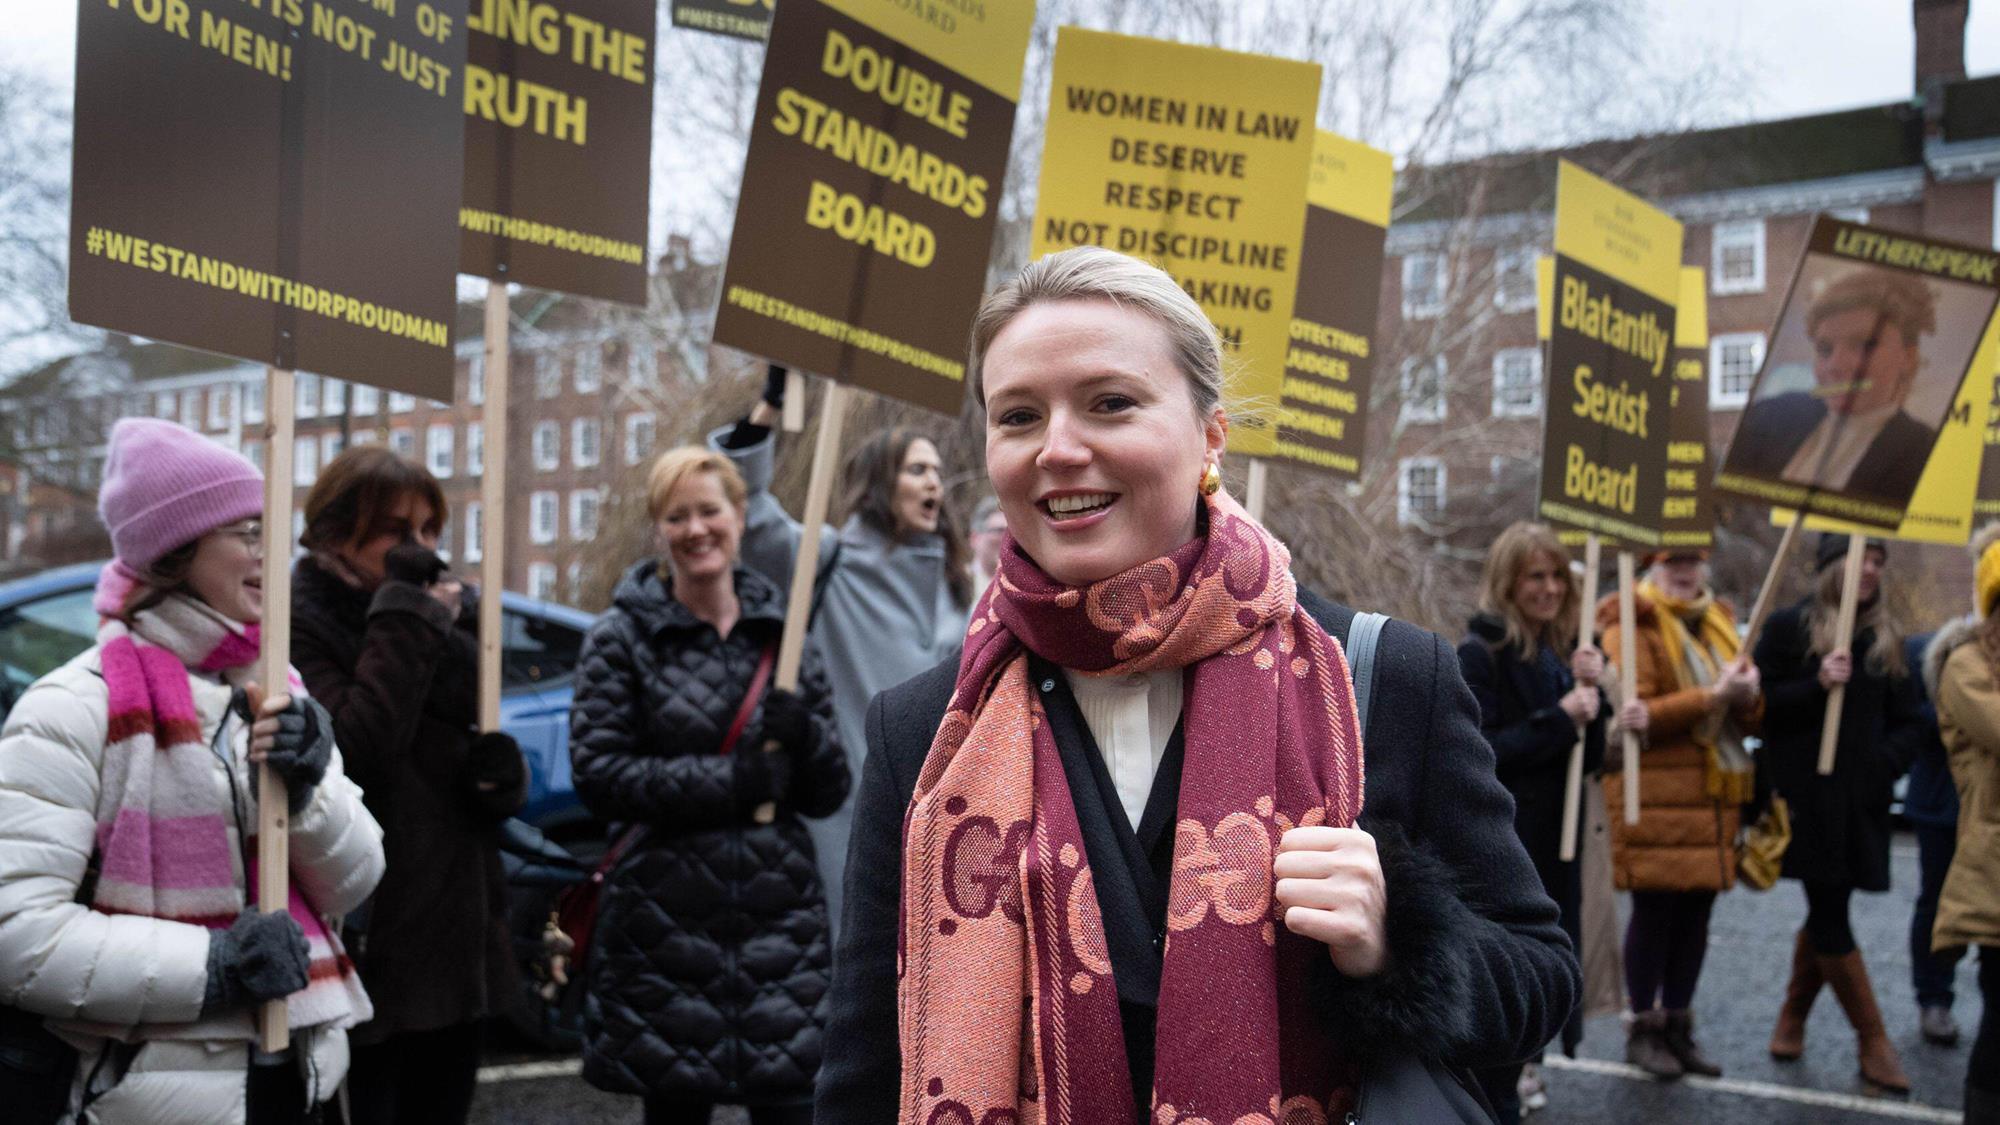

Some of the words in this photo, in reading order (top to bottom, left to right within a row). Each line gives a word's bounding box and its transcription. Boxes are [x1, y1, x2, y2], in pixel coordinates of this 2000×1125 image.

[107, 0, 190, 39] OR
[200, 10, 292, 82] MEN!
[311, 2, 376, 60] NOT
[380, 40, 451, 97] JUST
[415, 3, 453, 44] OF
[564, 12, 647, 84] THE
[822, 29, 972, 138] DOUBLE
[1066, 85, 1186, 127] WOMEN
[1195, 103, 1228, 132] IN
[1236, 110, 1300, 142] LAW
[772, 87, 989, 218] STANDARDS
[1110, 136, 1248, 180] DESERVE
[806, 180, 936, 268] BOARD
[1104, 180, 1242, 222] RESPECT
[1044, 217, 1108, 248] NOT
[1117, 226, 1288, 273] DISCIPLINE
[86, 227, 449, 348] #WESTANDWITHDRPROUDMAN
[1561, 275, 1668, 377] Blatantly
[727, 285, 966, 382] #WESTANDWITHDRPROUDMAN
[1573, 365, 1650, 439] Sexist
[1565, 443, 1638, 514] Board
